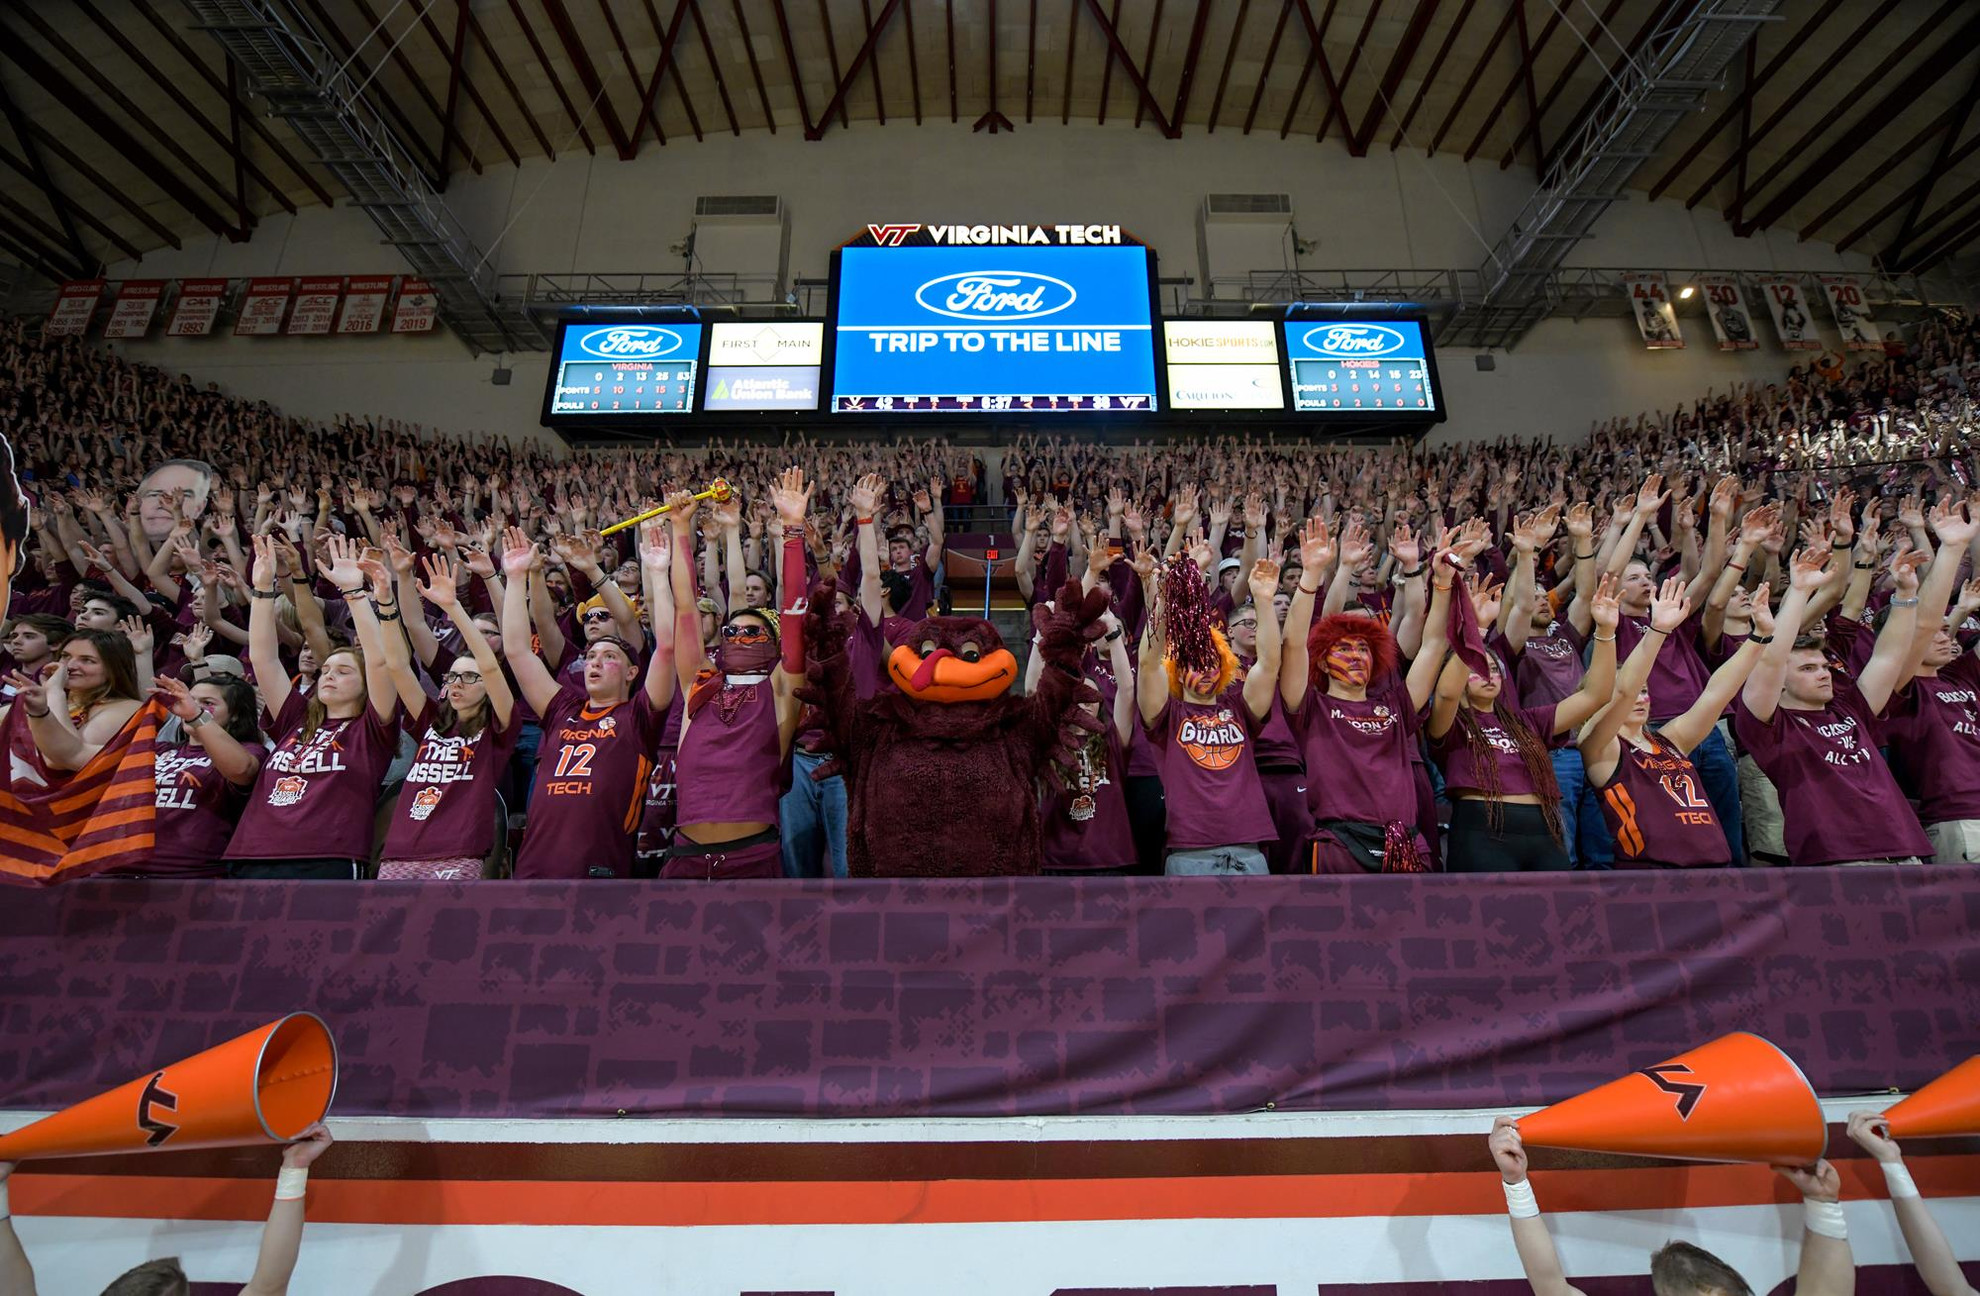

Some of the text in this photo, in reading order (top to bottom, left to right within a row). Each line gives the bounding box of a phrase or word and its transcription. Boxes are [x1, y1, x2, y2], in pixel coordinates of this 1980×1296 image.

[867, 223, 1121, 246] VT VIRGINIA TECH
[946, 276, 1045, 312] Ford
[1634, 283, 1665, 302] 44
[1706, 285, 1738, 306] 30
[1830, 285, 1861, 305] 20
[345, 320, 373, 331] 2016
[399, 318, 427, 330] 2019
[599, 330, 661, 353] Ford
[721, 339, 811, 348] FIRST MAIN
[868, 331, 1122, 353] TRIP TO THE LINE
[1323, 328, 1384, 351] Ford
[612, 363, 653, 371] VIRGINIA
[595, 372, 603, 381] 0
[616, 372, 624, 381] 2
[1327, 370, 1337, 379] 0
[1349, 370, 1357, 379] 2
[732, 378, 790, 389] Atlantic
[1297, 384, 1327, 392] POINTS
[560, 387, 590, 395] POINTS
[731, 388, 813, 400] Union Bank
[613, 401, 620, 409] 2
[655, 401, 662, 409] 2
[676, 401, 684, 409] 2
[875, 396, 893, 410] 42
[1119, 397, 1146, 409] VT
[1299, 399, 1327, 407] FOULS
[1354, 399, 1361, 407] 2
[1375, 399, 1383, 407] 2
[988, 534, 995, 546] 1
[986, 549, 999, 560] EXIT
[1180, 721, 1245, 745] GUARD
[425, 740, 459, 761] THE
[554, 743, 597, 777] 12
[1825, 750, 1848, 766] ALL
[406, 761, 474, 783] ASSELL
[547, 781, 592, 795] TECH
[1659, 774, 1709, 807] 12
